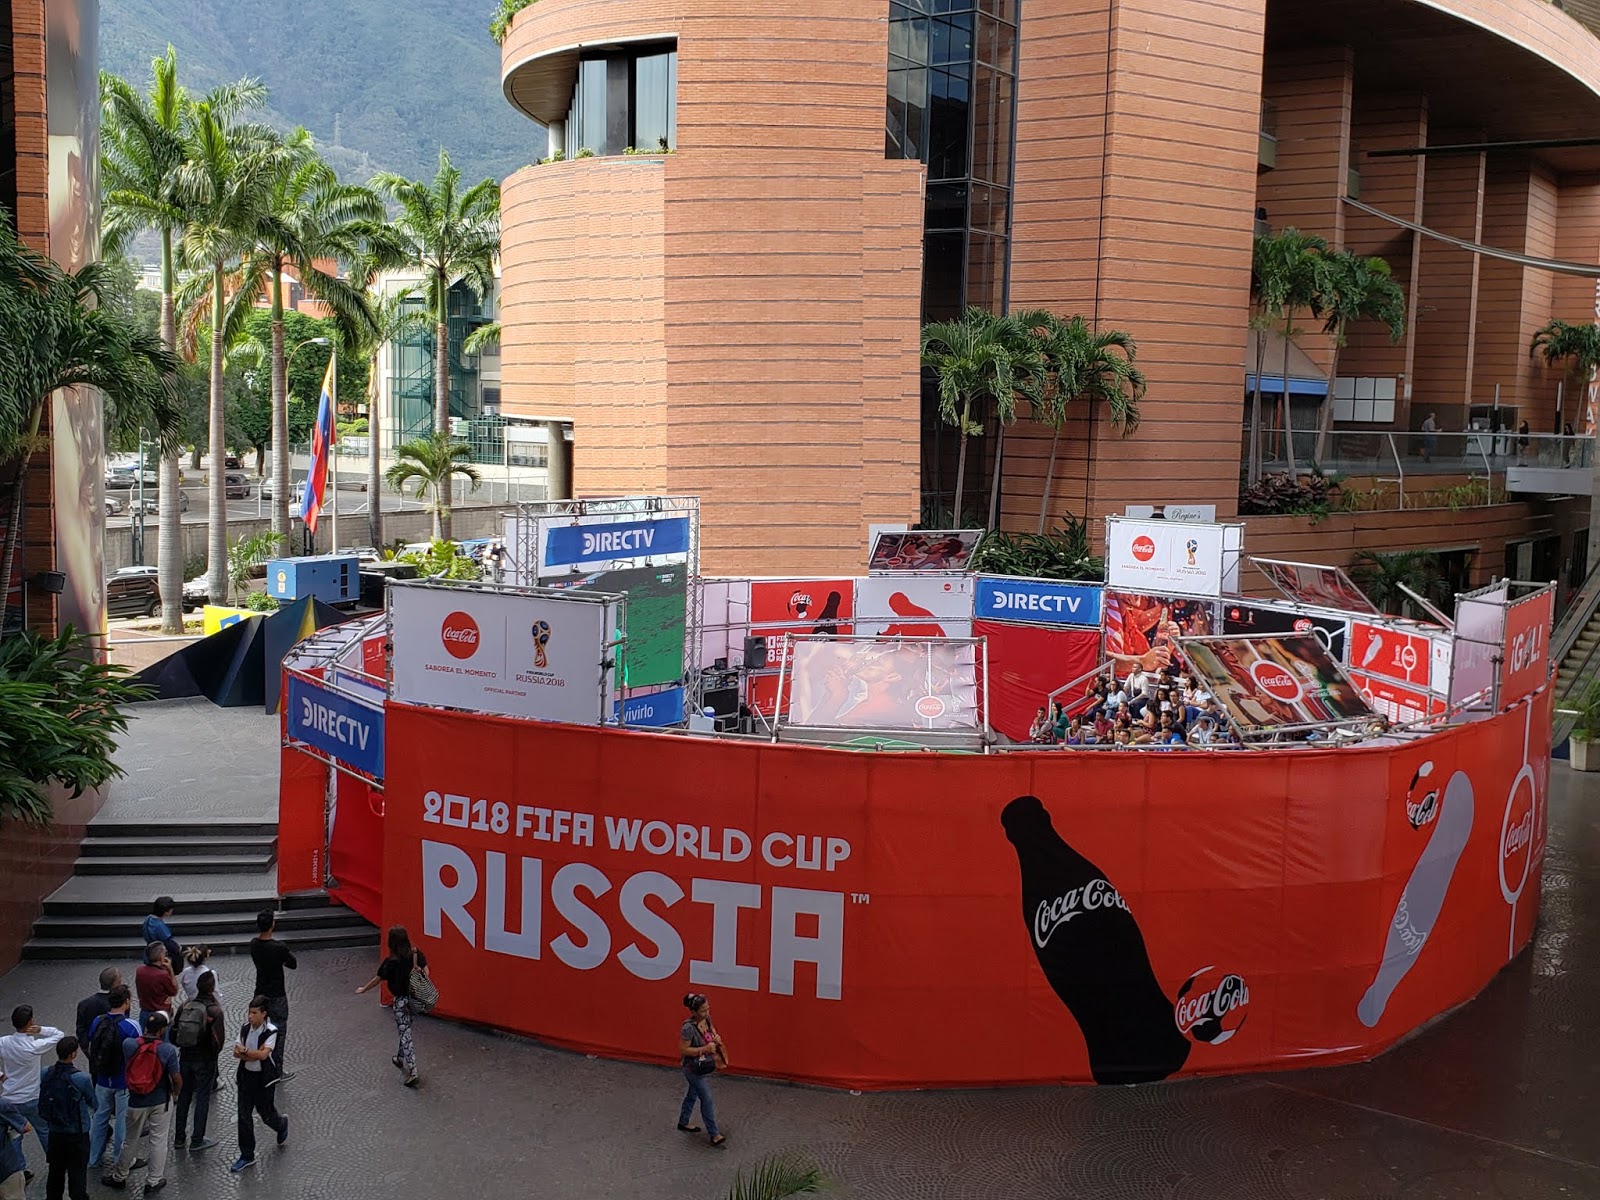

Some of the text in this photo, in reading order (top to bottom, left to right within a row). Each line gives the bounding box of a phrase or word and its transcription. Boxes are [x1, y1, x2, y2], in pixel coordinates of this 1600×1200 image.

[582, 528, 655, 555] DIRECTV
[992, 590, 1082, 613] DIRECTV
[443, 626, 478, 644] Coca-Cola
[424, 664, 454, 674] SABOREA
[464, 669, 497, 678] MOMENTO
[516, 673, 565, 687] RUSSIA 2018
[1260, 674, 1293, 687] Coca-Cola
[302, 696, 370, 751] DIRECTV
[423, 790, 852, 872] 2018 FIFA WORLD CUP
[421, 838, 845, 1001] RUSSIA
